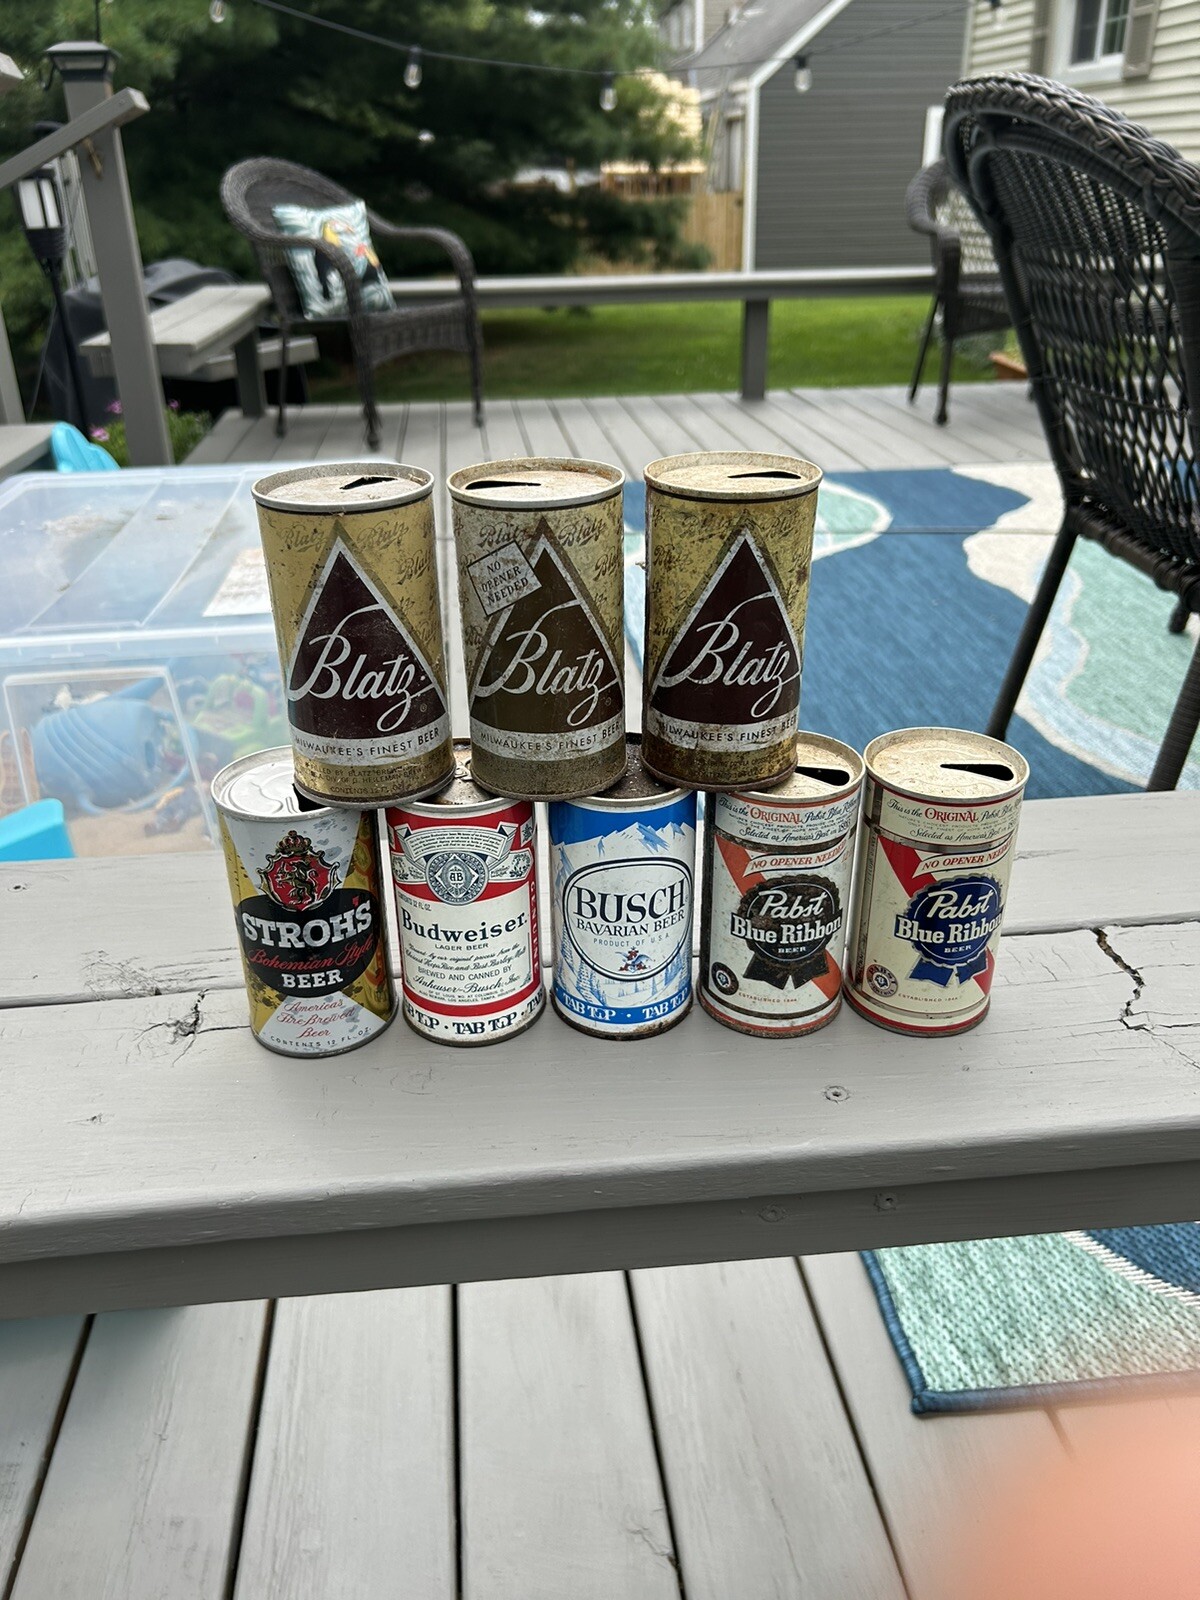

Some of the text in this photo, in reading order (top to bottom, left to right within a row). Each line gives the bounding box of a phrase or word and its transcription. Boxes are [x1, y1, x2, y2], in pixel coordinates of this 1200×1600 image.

[486, 560, 501, 574] NO
[481, 565, 522, 593] OPENER
[486, 576, 529, 607] NEEDED
[474, 600, 619, 727] Blatz
[658, 590, 801, 719] Blatz
[287, 604, 434, 732] Blatz
[370, 740, 413, 757] FINEST
[418, 727, 440, 746] BEER
[480, 721, 620, 751] MILWAUKEE'S FINEST BEER
[740, 727, 777, 742] FINEST
[887, 798, 904, 812] This
[911, 808, 923, 818] the
[924, 807, 980, 824] ORIGINAL
[739, 827, 769, 839] Selected
[909, 828, 943, 840] Selected
[750, 859, 767, 870] NO
[769, 855, 813, 867] OPENER
[922, 860, 940, 871] NO
[942, 852, 984, 866] OPENER
[572, 877, 687, 924] BUSCH
[758, 888, 829, 919] Pabst
[926, 889, 995, 920] Pabst
[241, 895, 373, 949] STROH'S
[576, 908, 686, 938] BAVARIAN BEER
[731, 913, 842, 944] Blue Ribbon
[895, 913, 1002, 944] Blue Ribbon
[250, 933, 374, 971] Bohemian Style
[434, 942, 489, 952] LAGER BEER
[593, 937, 630, 948] PRODUCT
[635, 938, 645, 947] OF
[778, 946, 807, 954] BEER
[943, 944, 973, 953] BEER
[280, 968, 344, 989] BEER
[448, 972, 465, 981] AND
[468, 969, 500, 981] CANNED
[502, 964, 513, 974] BY
[563, 993, 586, 1014] TAB
[642, 1002, 670, 1020] TAB
[297, 1027, 331, 1039] Beer
[452, 1021, 486, 1035] TAB
[269, 1035, 322, 1048] CONTENTS
